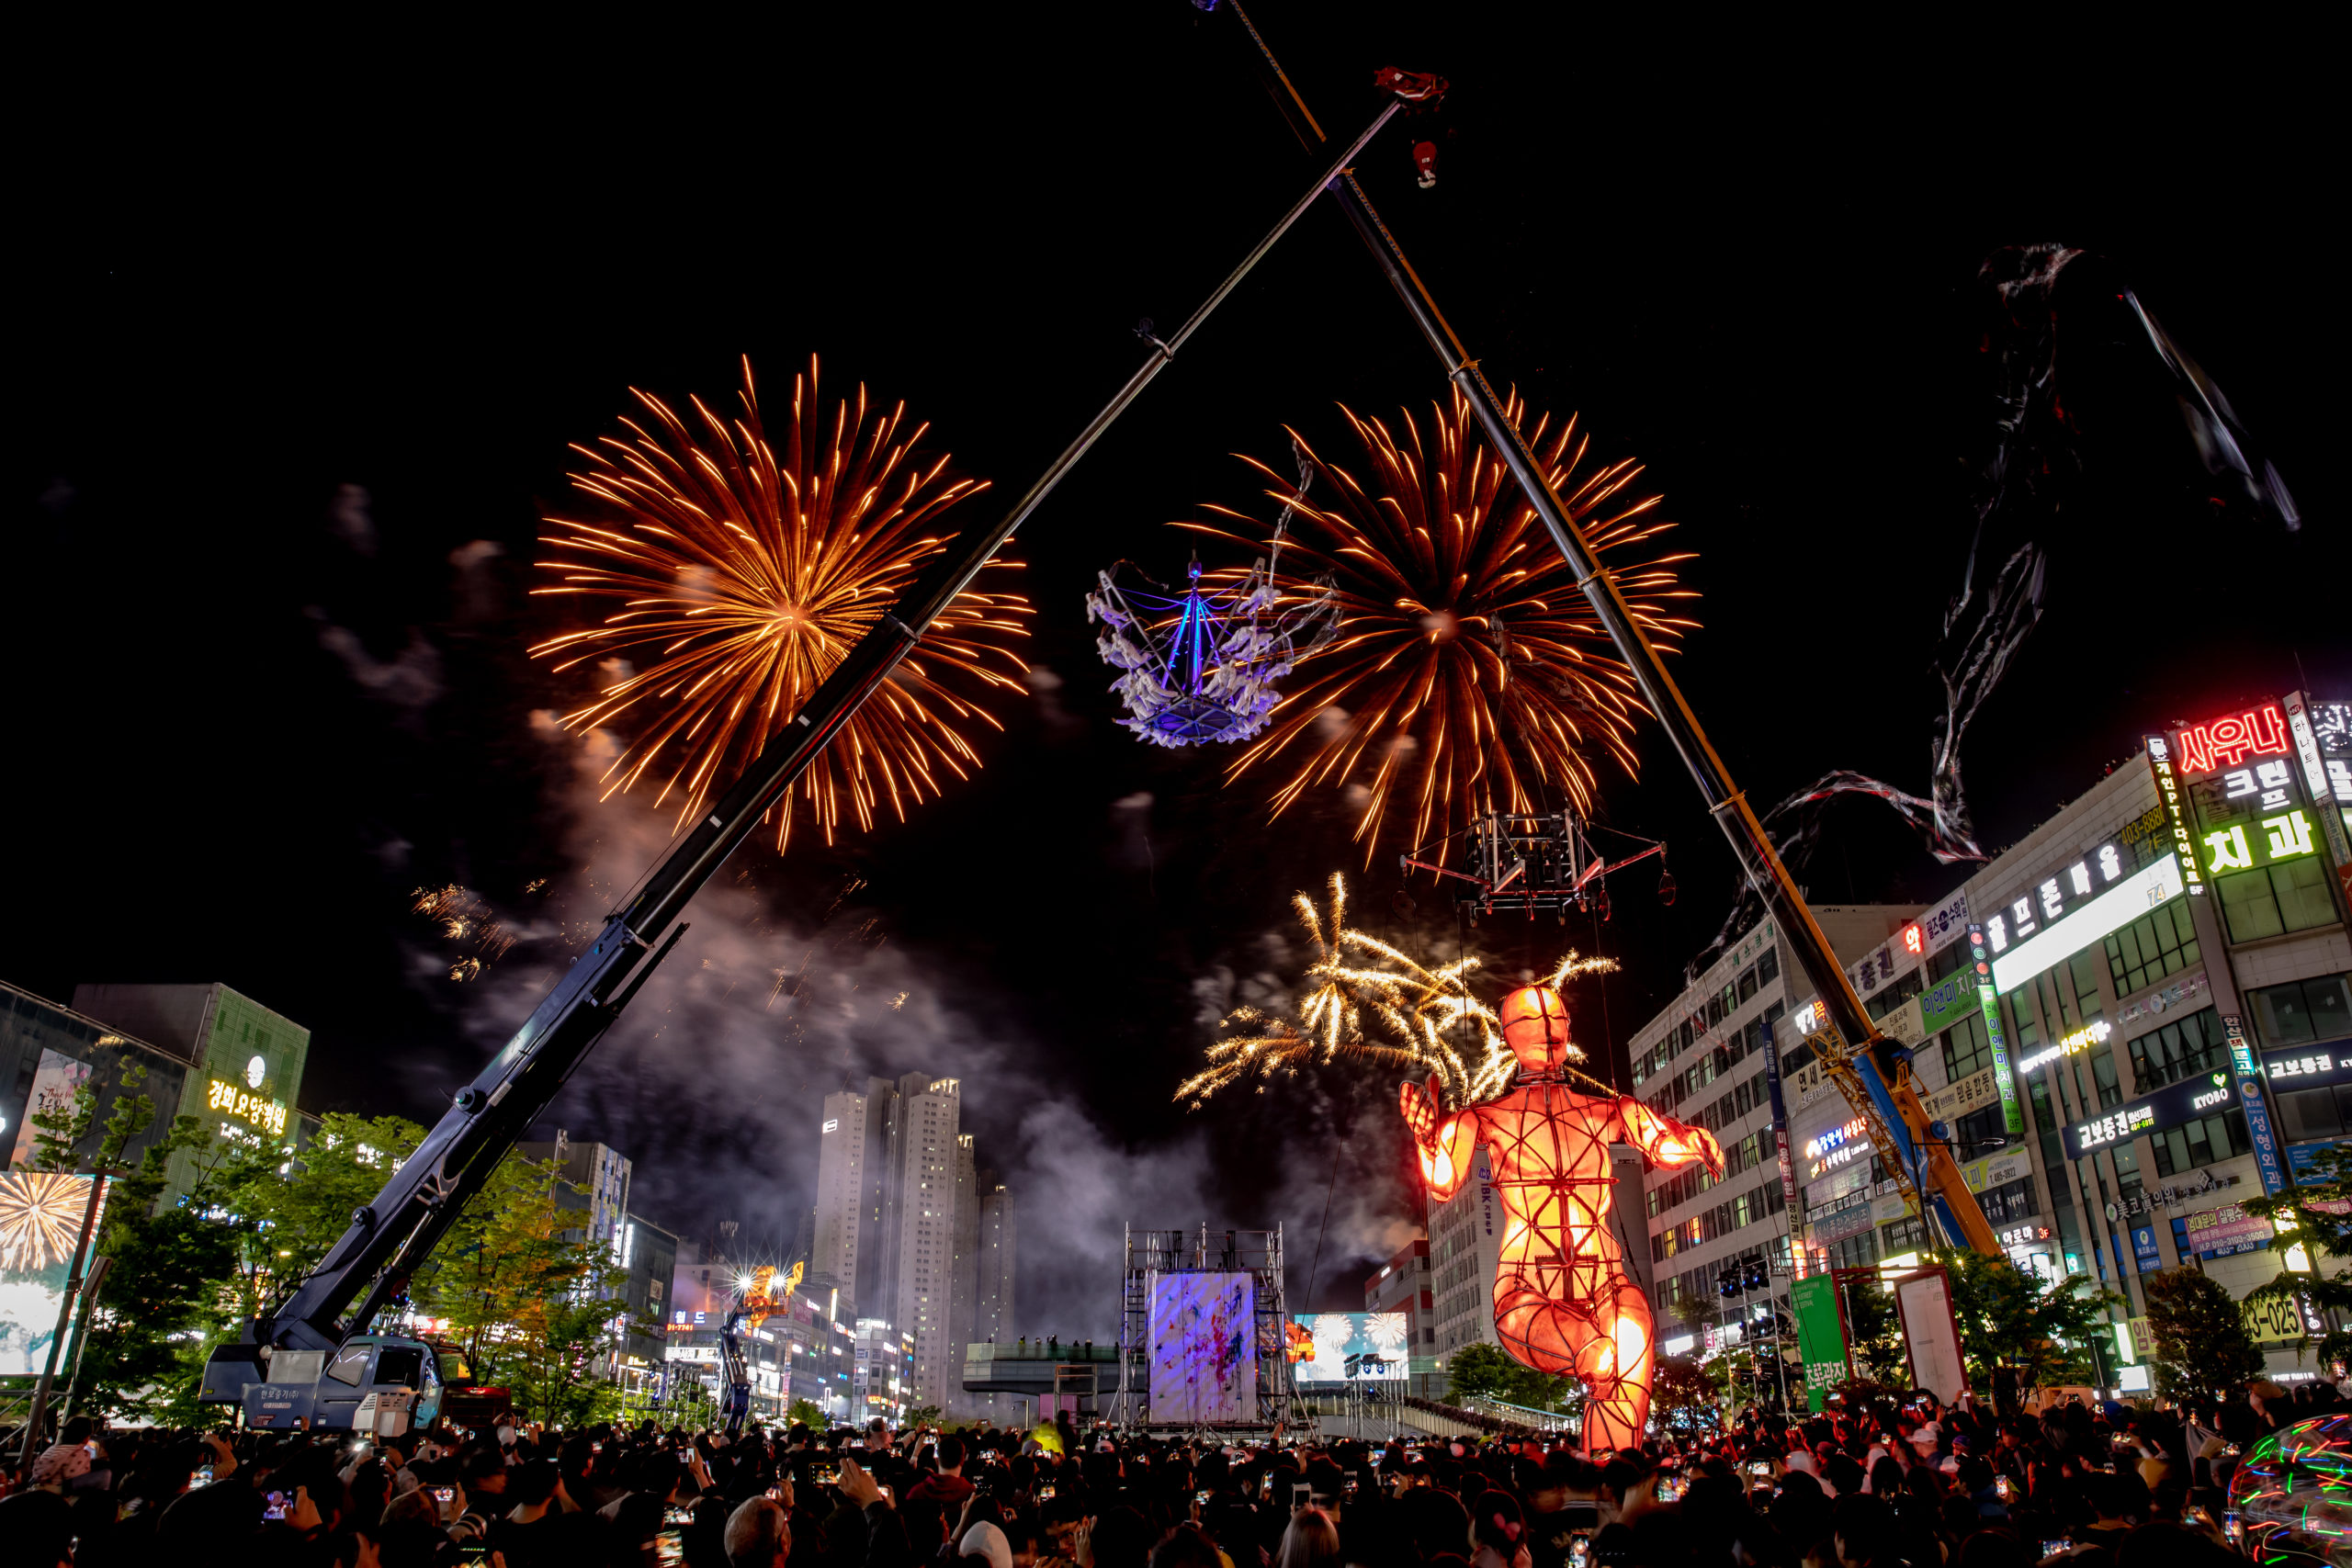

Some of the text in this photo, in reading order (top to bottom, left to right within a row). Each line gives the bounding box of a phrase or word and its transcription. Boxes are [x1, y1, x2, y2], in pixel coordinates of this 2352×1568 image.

[2179, 706, 2288, 773] 사우나
[2294, 720, 2319, 780] 하나투어
[2203, 809, 2314, 873] 치과
[1905, 924, 1921, 953] 약
[1988, 1017, 2016, 1103] 이앤미치과
[2269, 1055, 2334, 1078] 교보증권
[2192, 1088, 2229, 1110] KYOBO
[2008, 1119, 2020, 1129] 3F
[2078, 1110, 2130, 1149] 교보증권
[2252, 1115, 2283, 1187] 성형외과
[1480, 1182, 1492, 1203] IBK
[2218, 1208, 2244, 1224] 실평수
[2002, 1224, 2050, 1246] 아로마 3F
[2211, 1231, 2266, 1247] 010-3103-3500
[675, 1310, 706, 1325] 월드
[1805, 1359, 1847, 1392] 초록광장
